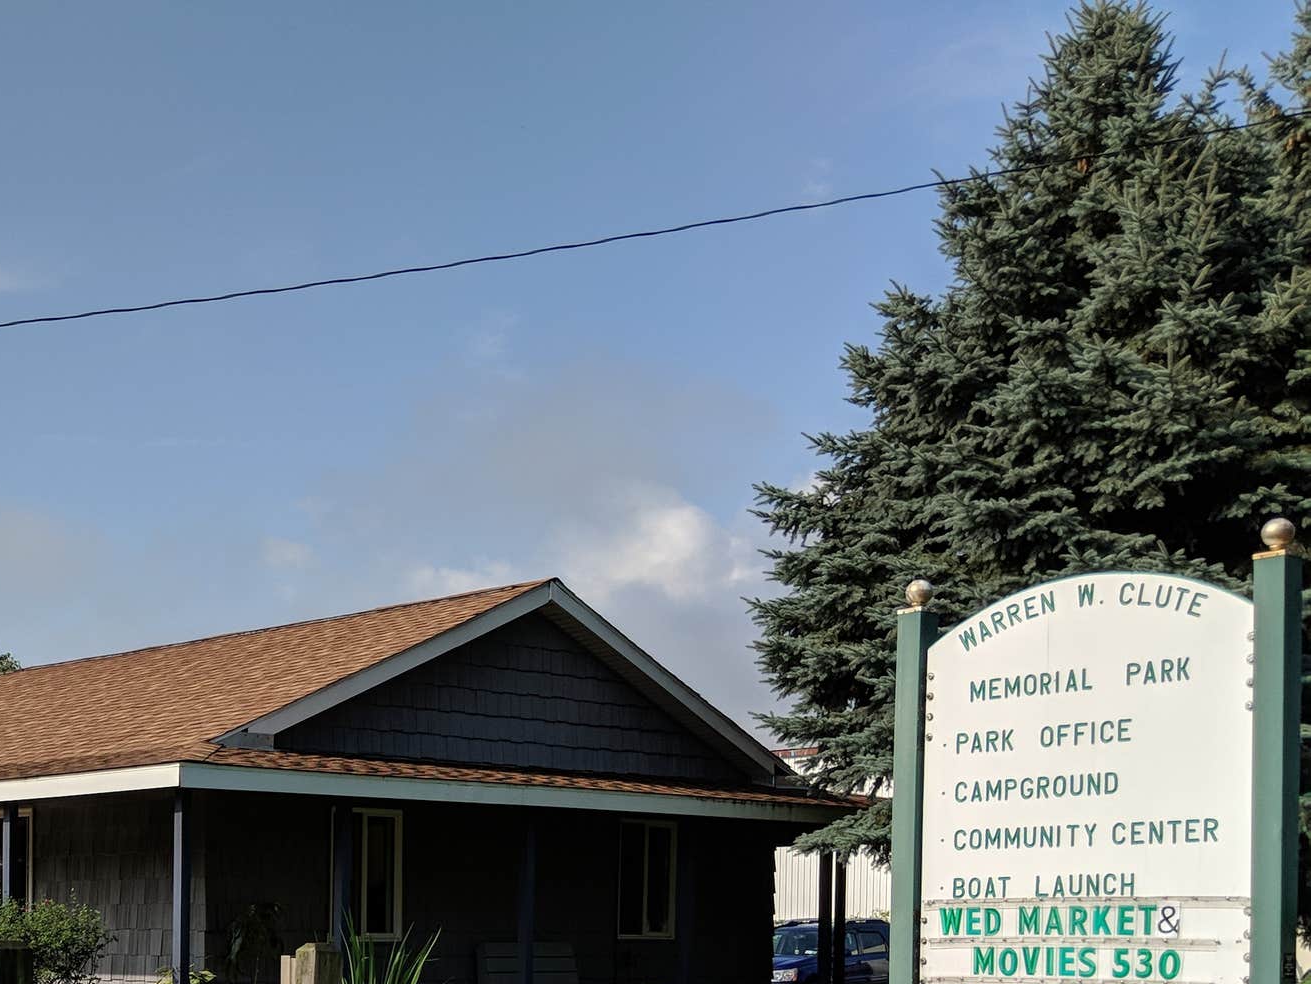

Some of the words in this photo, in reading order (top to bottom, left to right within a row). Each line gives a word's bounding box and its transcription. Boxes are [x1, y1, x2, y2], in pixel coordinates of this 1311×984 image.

[958, 590, 1057, 652] WARREN
[1077, 583, 1105, 608] W.
[1119, 582, 1209, 618] CLUTE
[970, 668, 1093, 703] MEMORIAL
[1126, 656, 1191, 686] PARK
[956, 728, 1015, 754] PARK
[1040, 718, 1133, 748] OFFICE
[954, 771, 1119, 803] CAMPGROUND
[953, 823, 1097, 850] COMMUNITY
[1112, 818, 1220, 845] CENTER
[952, 876, 1011, 900] BOAT
[1035, 872, 1136, 898] LAUNCH
[939, 907, 1002, 936] WED
[973, 946, 1098, 978] MOVIES
[1112, 948, 1182, 980] 530
